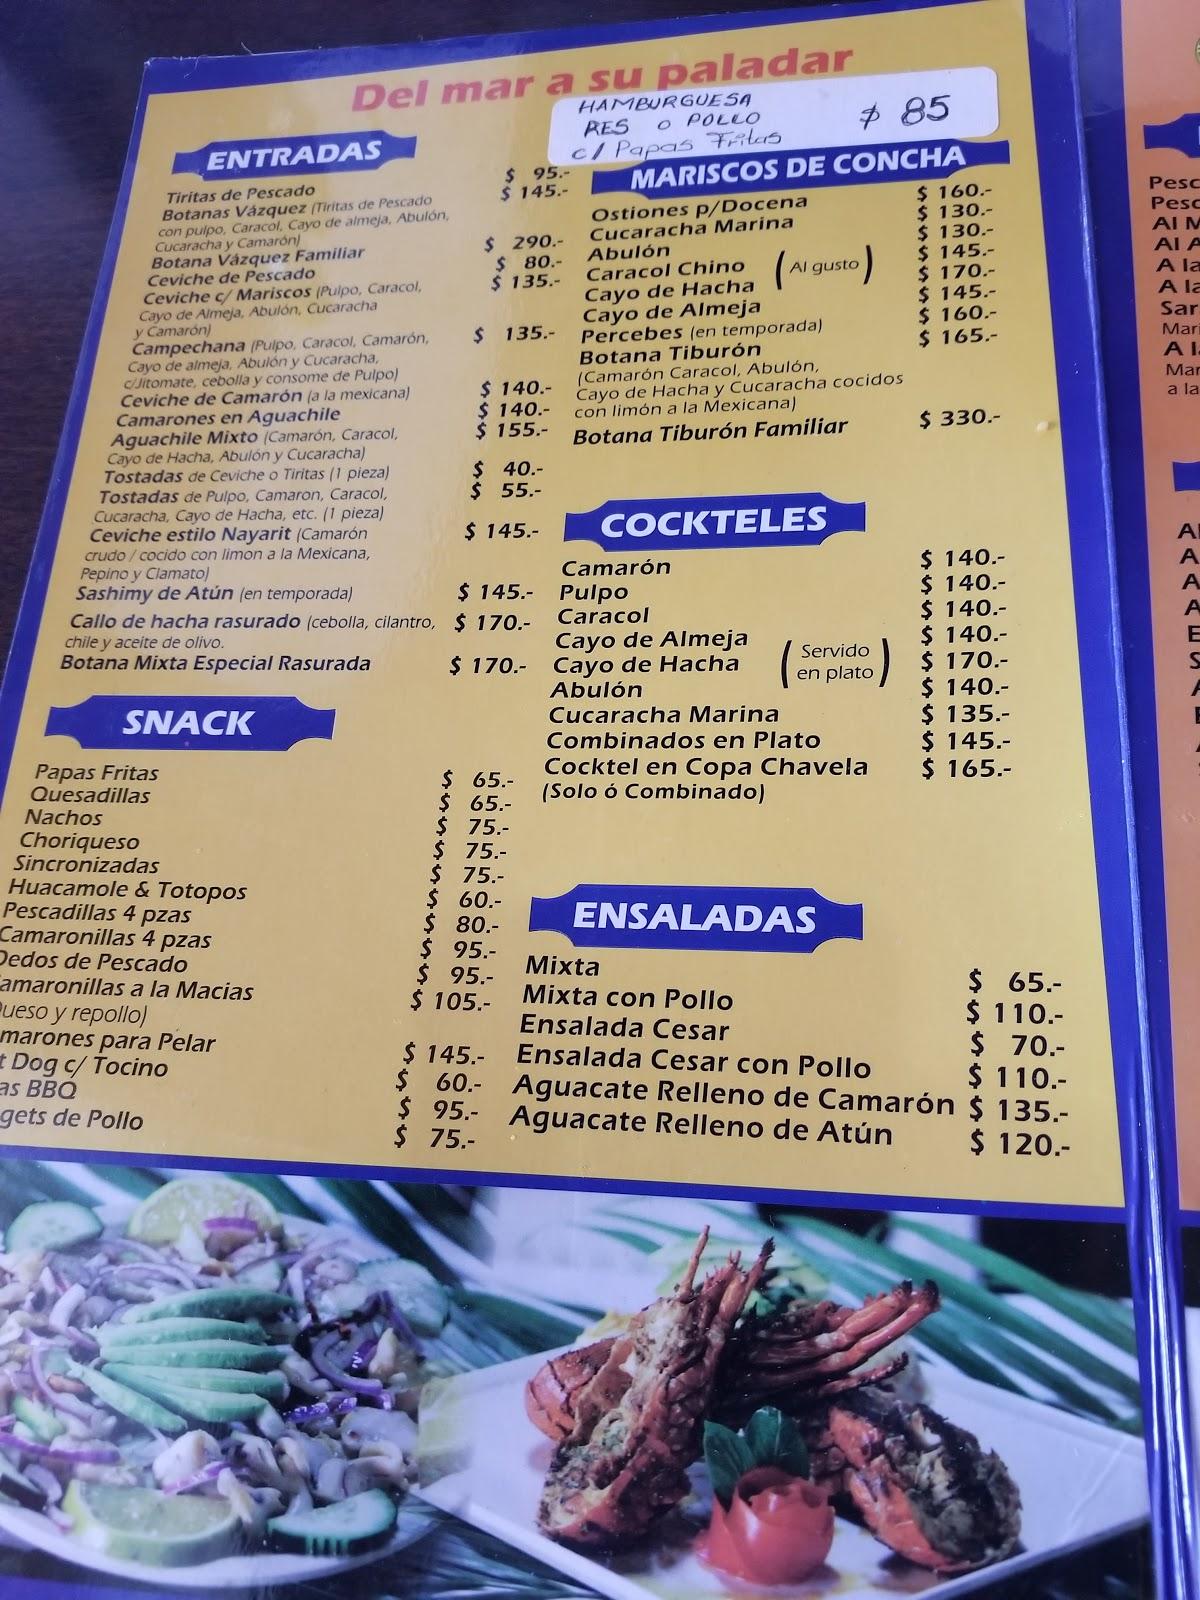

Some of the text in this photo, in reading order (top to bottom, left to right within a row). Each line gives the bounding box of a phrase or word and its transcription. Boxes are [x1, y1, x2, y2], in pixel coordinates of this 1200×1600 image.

[352, 48, 854, 112] Del mar a su paladar
[578, 93, 752, 114] HAMBURGUESA
[859, 95, 951, 130] $ 85
[583, 119, 629, 138] RES
[687, 112, 760, 127] POLLO
[207, 140, 382, 171] ENTRADAS
[615, 140, 693, 160] Papas
[631, 145, 967, 190] MARISCOS DE CONCHA
[167, 185, 315, 204] Tiritas de Pescado
[162, 209, 230, 221] Botanas
[236, 205, 307, 219] Vázquez
[358, 200, 374, 210] de
[379, 196, 432, 208] Pescado
[592, 197, 807, 222] Ostiones p/Docena
[158, 229, 181, 237] con
[289, 220, 321, 230] Cayo
[325, 218, 341, 227] de
[155, 240, 222, 252] Cucaracha
[225, 241, 233, 252] y
[587, 244, 670, 262] Abulón
[148, 267, 315, 287] Ceviche de Pescado
[790, 260, 859, 275] Al gusto
[581, 318, 822, 344] Percebes (en temporada)
[580, 342, 761, 365] Botana Tiburón
[121, 386, 410, 408] Ceviche de Camarón (a la mexicana)
[577, 373, 903, 404] Cayo de Hacha y Cucaracha cocidos
[117, 408, 340, 427] Camarones en Aguachile
[600, 505, 827, 538] COCKTELES
[90, 526, 367, 545] Ceviche estilo Nayarit (Camarón
[562, 559, 670, 576] Camarón
[76, 585, 352, 605] Sashimy de Atún (en temporada)
[560, 584, 628, 604] Pulpo
[71, 614, 435, 632] Callo de hacha rasurado (cebolla, cilantro,
[558, 607, 649, 624] Caracol
[556, 630, 747, 653] Cayo de Almeja
[801, 643, 869, 658] Servido
[60, 655, 371, 675] Botana Mixta Especial Rasurada
[797, 665, 873, 683] en plato
[550, 681, 642, 698] Abulón
[122, 709, 256, 736] SNACK
[35, 764, 159, 784] Papas Fritas
[545, 758, 867, 780] Cocktel en Copa Chavela
[31, 786, 151, 803] Quesadillas
[543, 783, 764, 804] (Solo ó Combinado)
[24, 809, 103, 826] Nachos
[20, 832, 140, 854] Choriqueso
[13, 855, 160, 874] Sincronizadas
[8, 878, 247, 904] Huacamole & Totopos
[3, 902, 192, 927] Pescadillas 4 pzas
[573, 902, 816, 934] ENSALADAS
[64, 953, 91, 969] de
[97, 953, 188, 973] Pescado
[526, 955, 599, 976] Mixta
[523, 984, 733, 1010] Mixta con Pollo
[520, 1013, 730, 1041] Ensalada Cesar
[512, 1074, 954, 1115] Aguacate Relleno de Camarón
